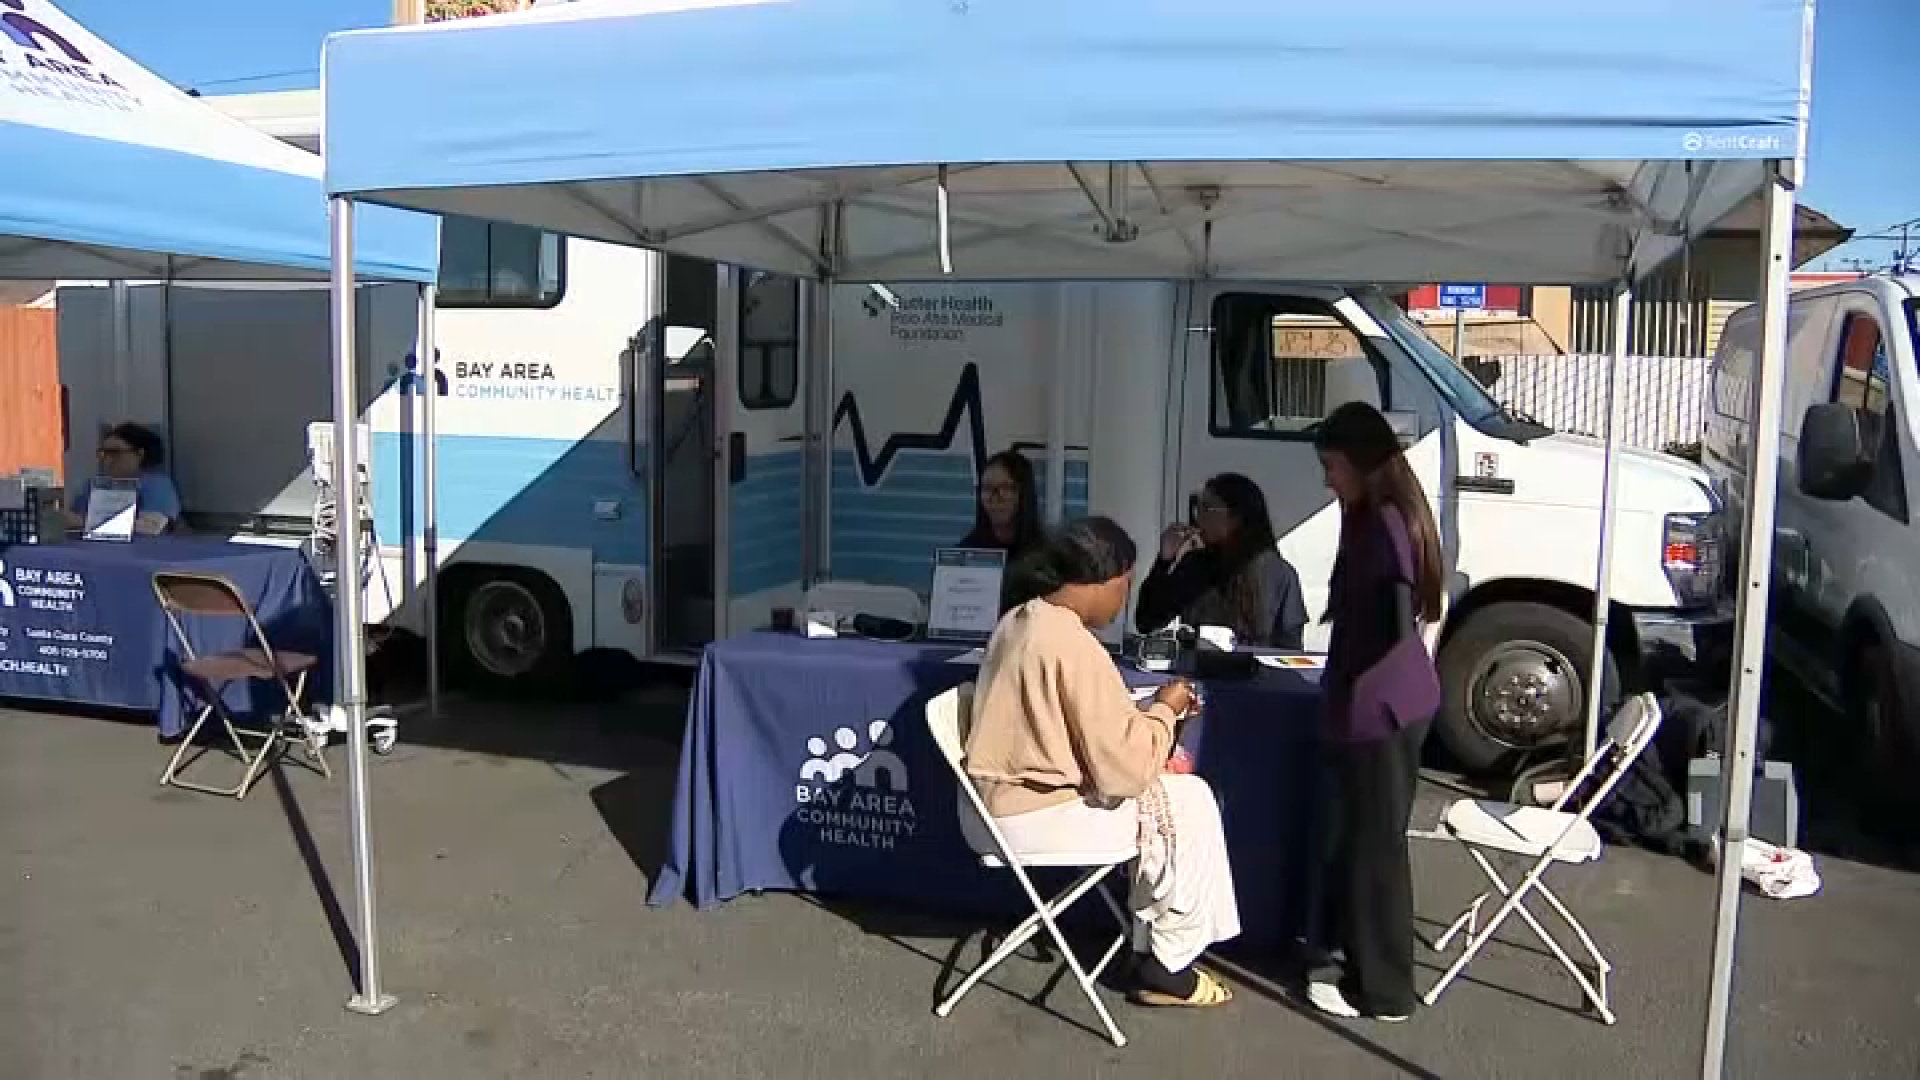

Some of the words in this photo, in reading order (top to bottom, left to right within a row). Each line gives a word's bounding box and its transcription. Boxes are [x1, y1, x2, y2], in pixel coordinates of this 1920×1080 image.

[941, 295, 993, 311] Health
[455, 361, 494, 379] BAY
[501, 363, 555, 380] AREA
[456, 383, 555, 399] COMMUNITY
[15, 567, 43, 583] BAY
[46, 570, 84, 587] AREA
[16, 585, 86, 601] COMMUNITY
[30, 599, 74, 611] HEALTH
[79, 631, 113, 645] County
[796, 785, 841, 806] BAY
[850, 791, 916, 817] AREA
[797, 807, 916, 836] COMMUNITY
[820, 827, 895, 849] HEALTH
